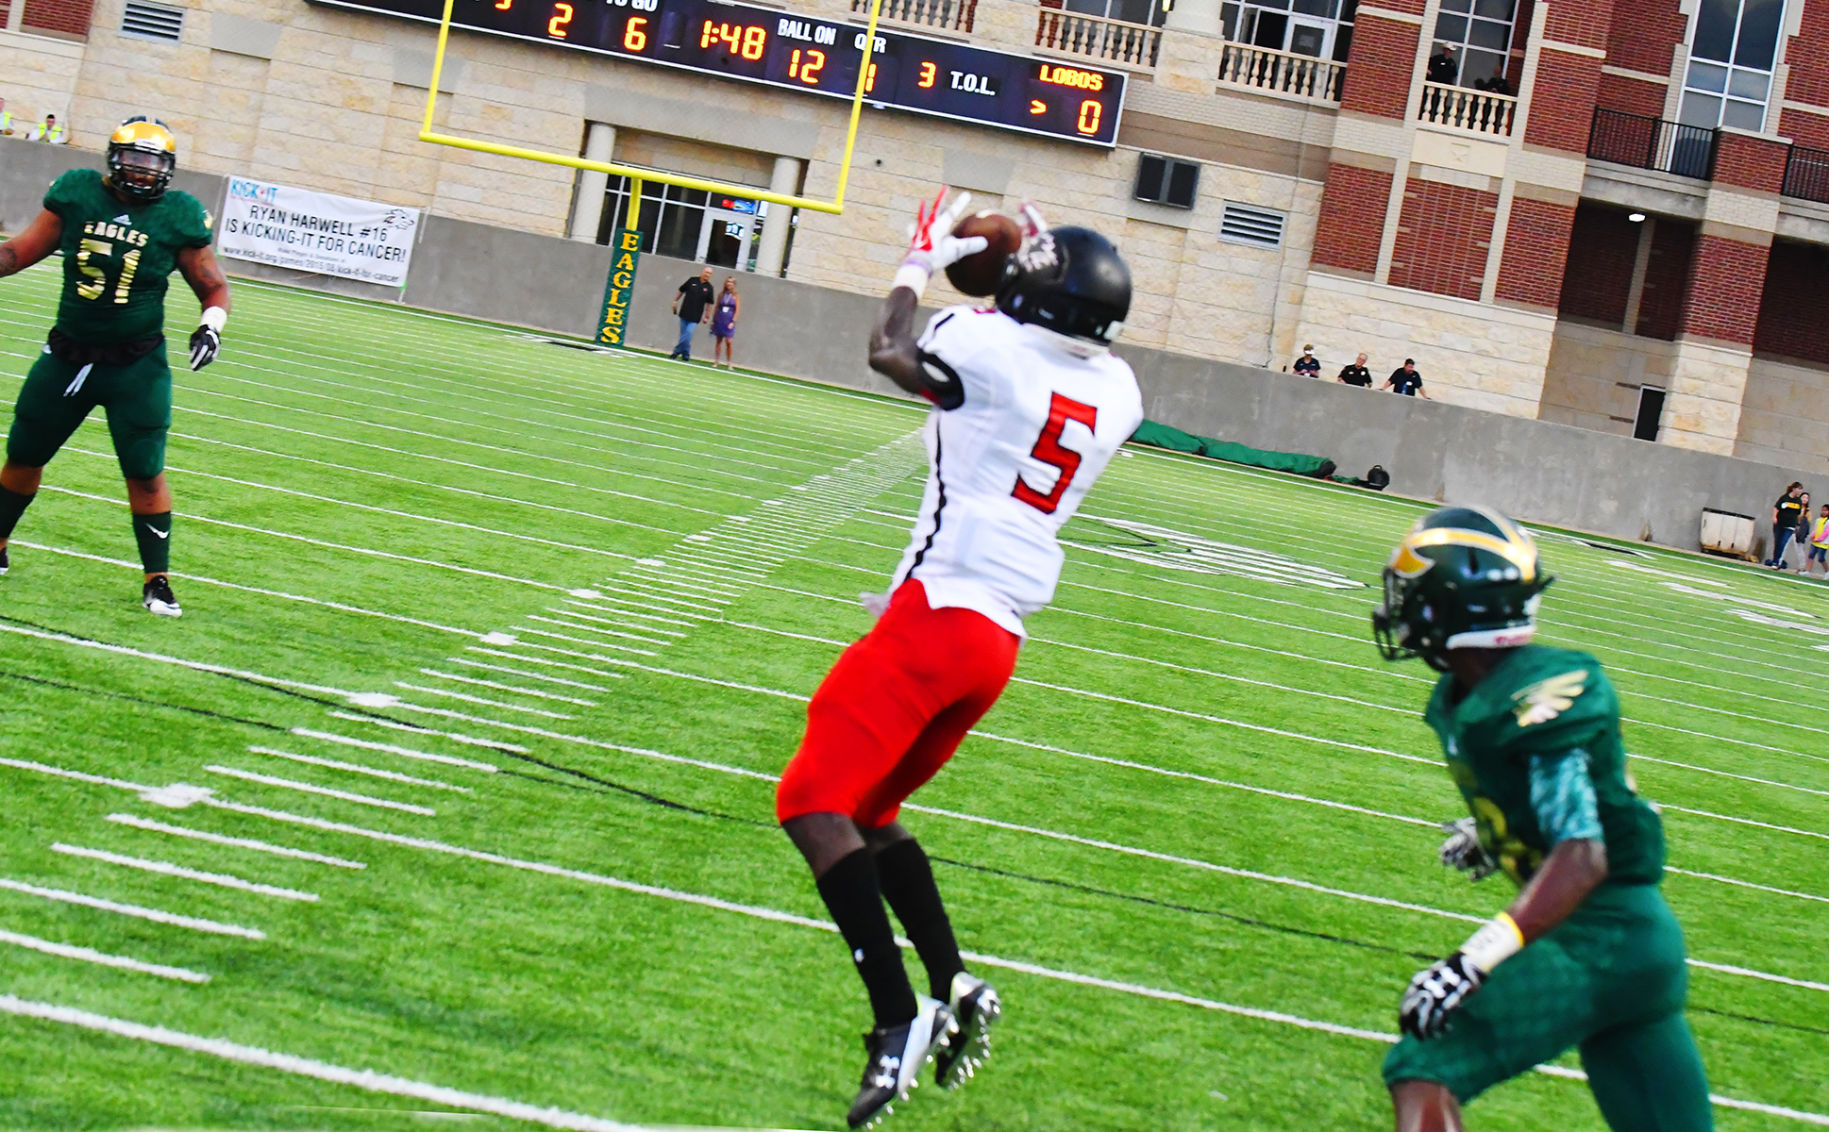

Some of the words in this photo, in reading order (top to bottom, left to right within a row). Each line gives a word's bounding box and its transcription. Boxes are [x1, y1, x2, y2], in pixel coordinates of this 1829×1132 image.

[548, 3, 573, 37] 2
[624, 16, 648, 51] 6
[777, 18, 812, 42] BALL
[814, 27, 836, 46] ON
[701, 20, 766, 60] 1:48
[854, 33, 887, 53] QR
[788, 48, 825, 84] 12
[918, 61, 937, 88] 3
[949, 70, 996, 96] T.O.L.
[1039, 64, 1103, 91] LOBOS
[1077, 100, 1102, 135] 0
[84, 221, 149, 248] EAGLES
[225, 218, 237, 232] IS
[242, 221, 313, 248] KICKING-IT
[317, 235, 344, 253] FOR
[348, 240, 407, 262] CANCER!
[250, 205, 287, 223] RYAN
[291, 214, 354, 237] HARWELL
[359, 225, 388, 242] #16
[76, 237, 142, 304] 51
[600, 232, 640, 344] EAGLES
[1011, 391, 1098, 515] 5
